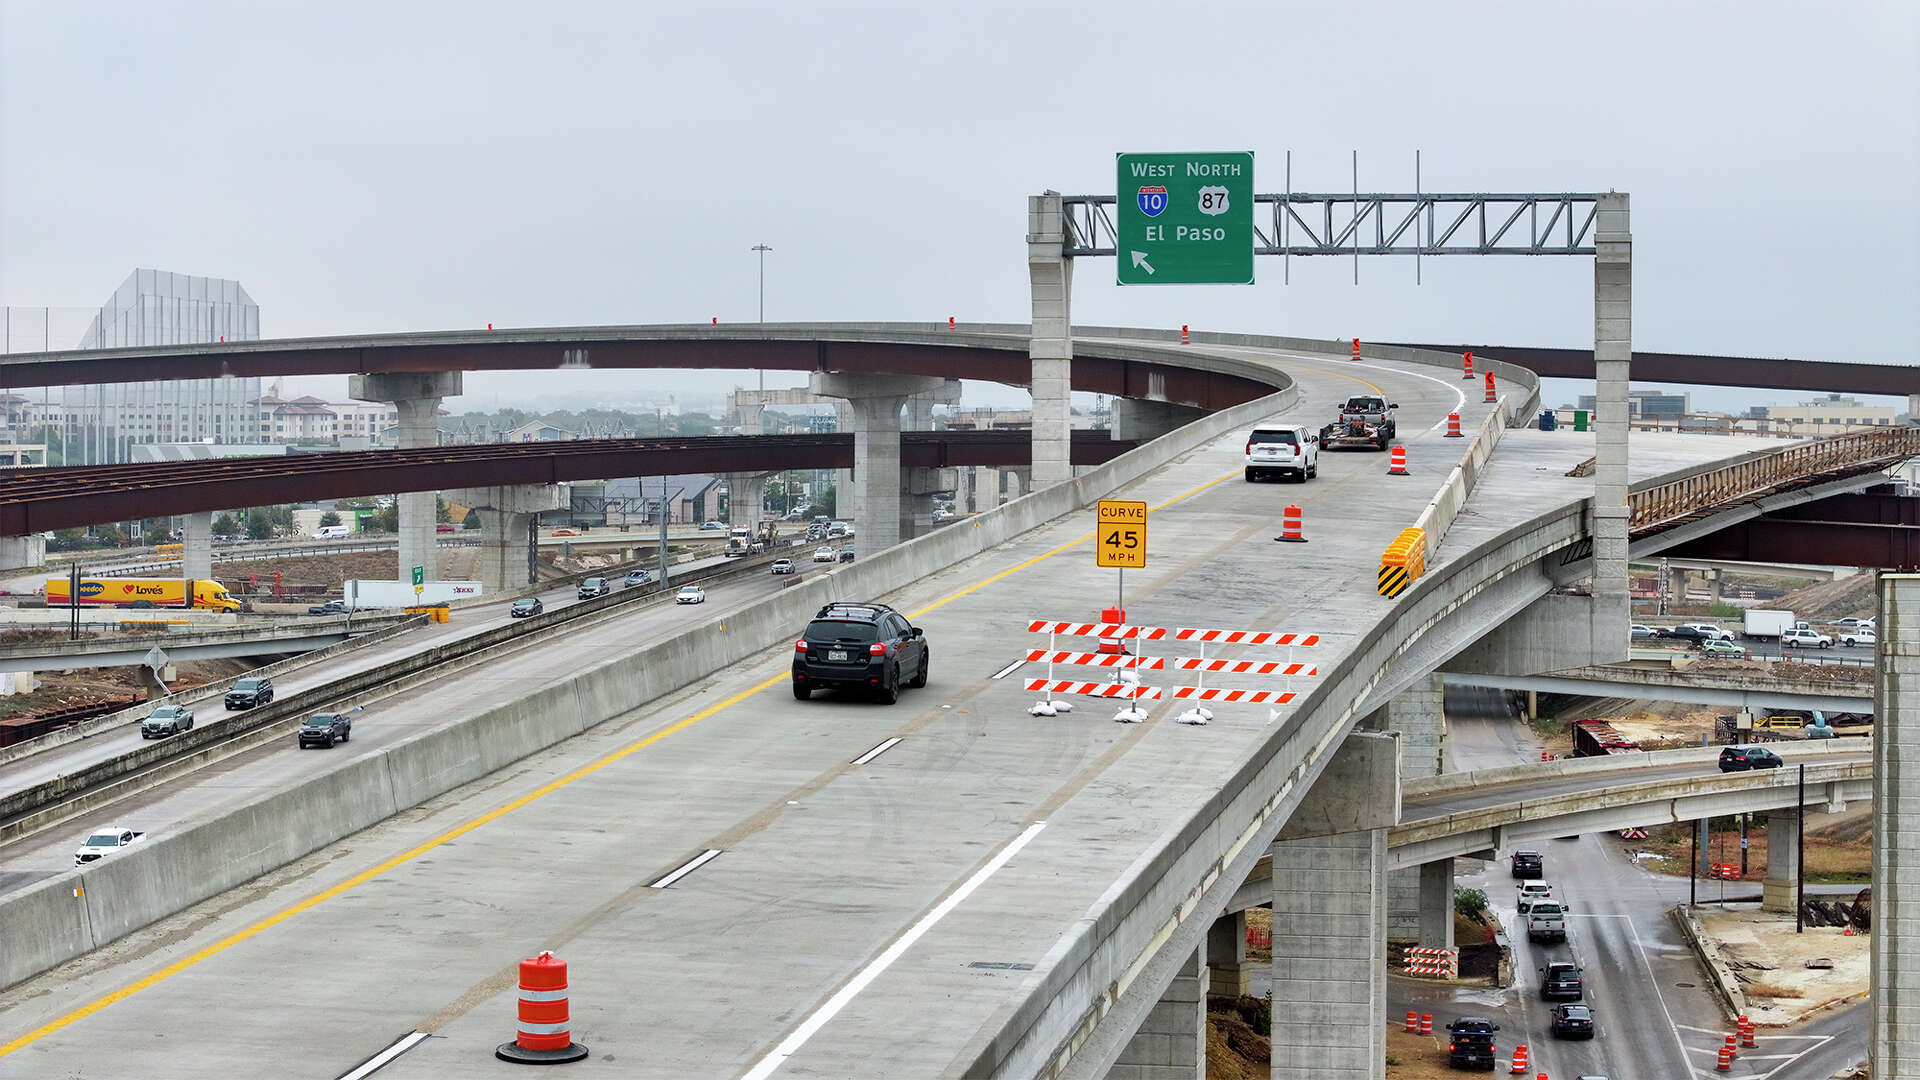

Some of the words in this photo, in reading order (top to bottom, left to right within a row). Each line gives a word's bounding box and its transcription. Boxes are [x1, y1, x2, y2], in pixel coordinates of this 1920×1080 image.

[1130, 162, 1175, 177] WEST
[1186, 162, 1241, 177] NORTH
[1143, 194, 1162, 210] 10
[1201, 192, 1226, 209] 87
[1146, 225, 1165, 241] El
[1176, 225, 1226, 241] Paso
[1101, 507, 1143, 518] CURVE
[1105, 530, 1138, 549] 45
[1108, 552, 1135, 561] MPH
